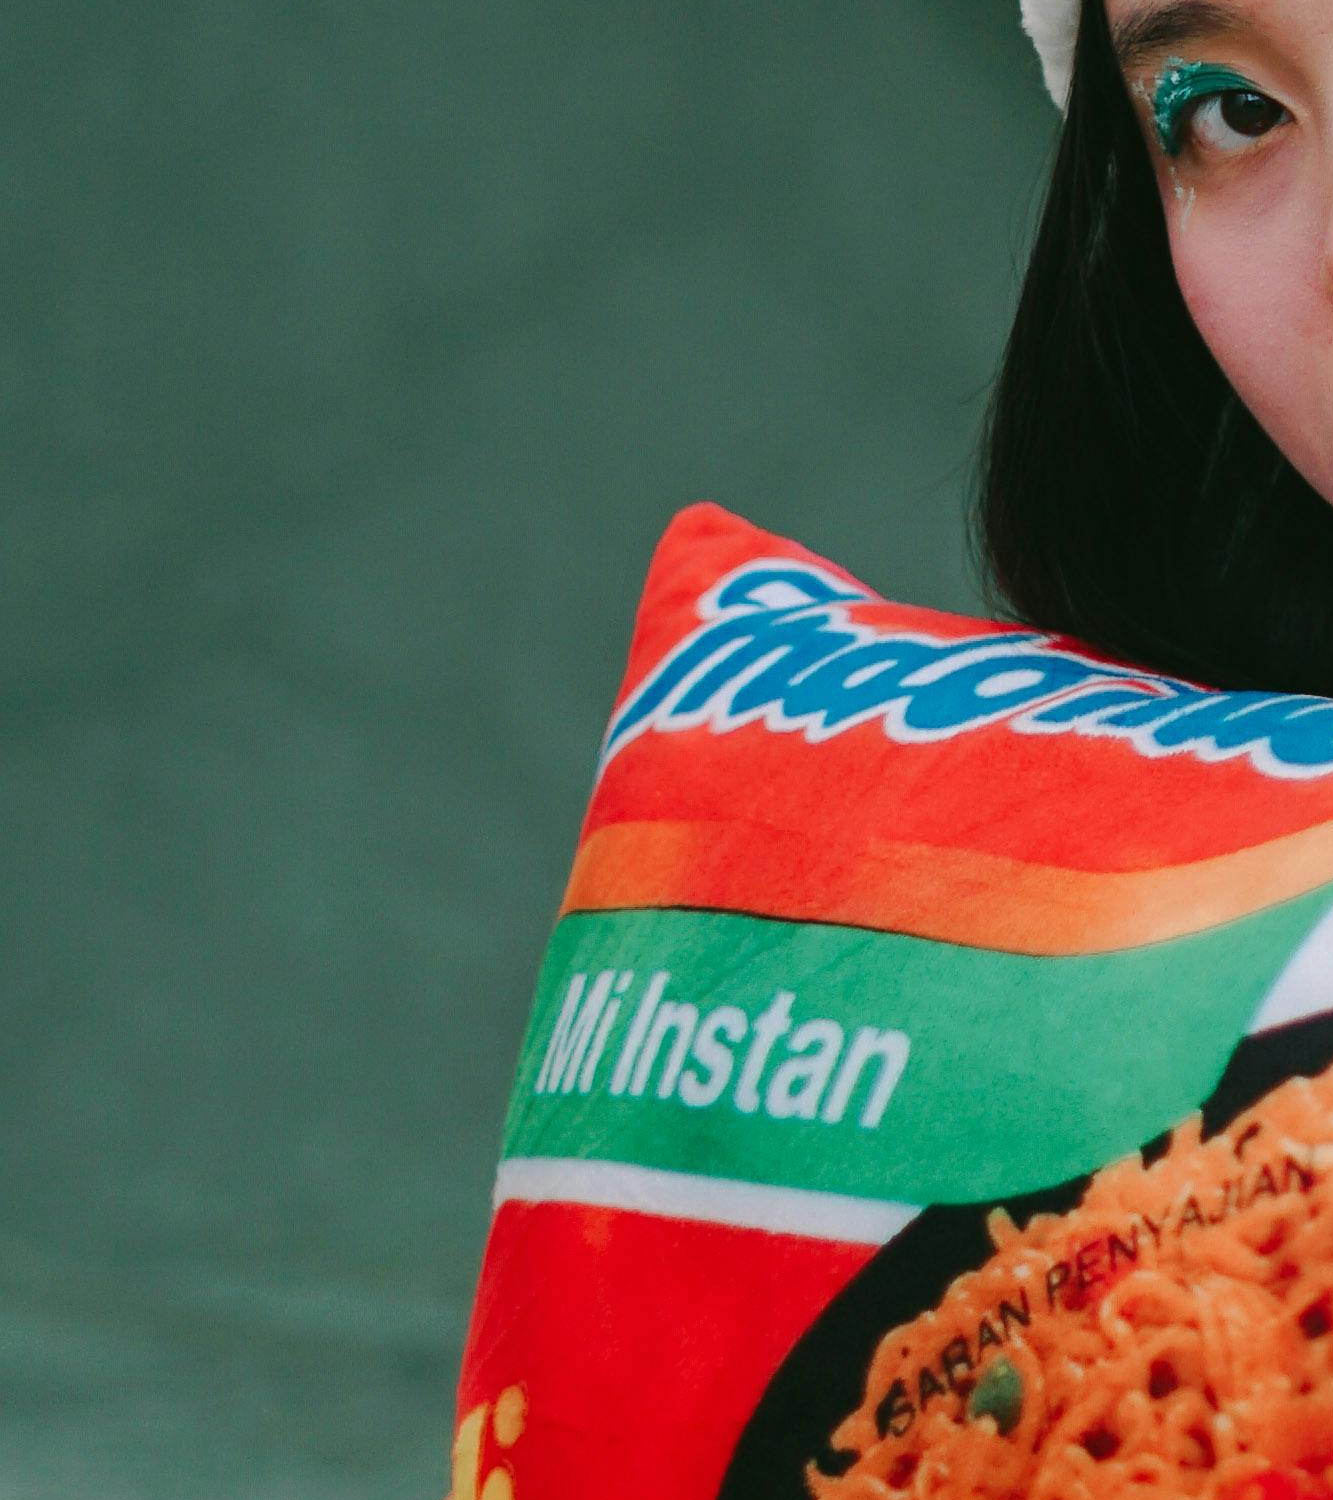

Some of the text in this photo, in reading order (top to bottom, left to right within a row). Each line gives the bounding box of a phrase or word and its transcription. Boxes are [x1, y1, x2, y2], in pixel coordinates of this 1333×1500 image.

[535, 969, 912, 1129] Mi Instan
[1046, 1156, 1317, 1312] PENYAJIAN
